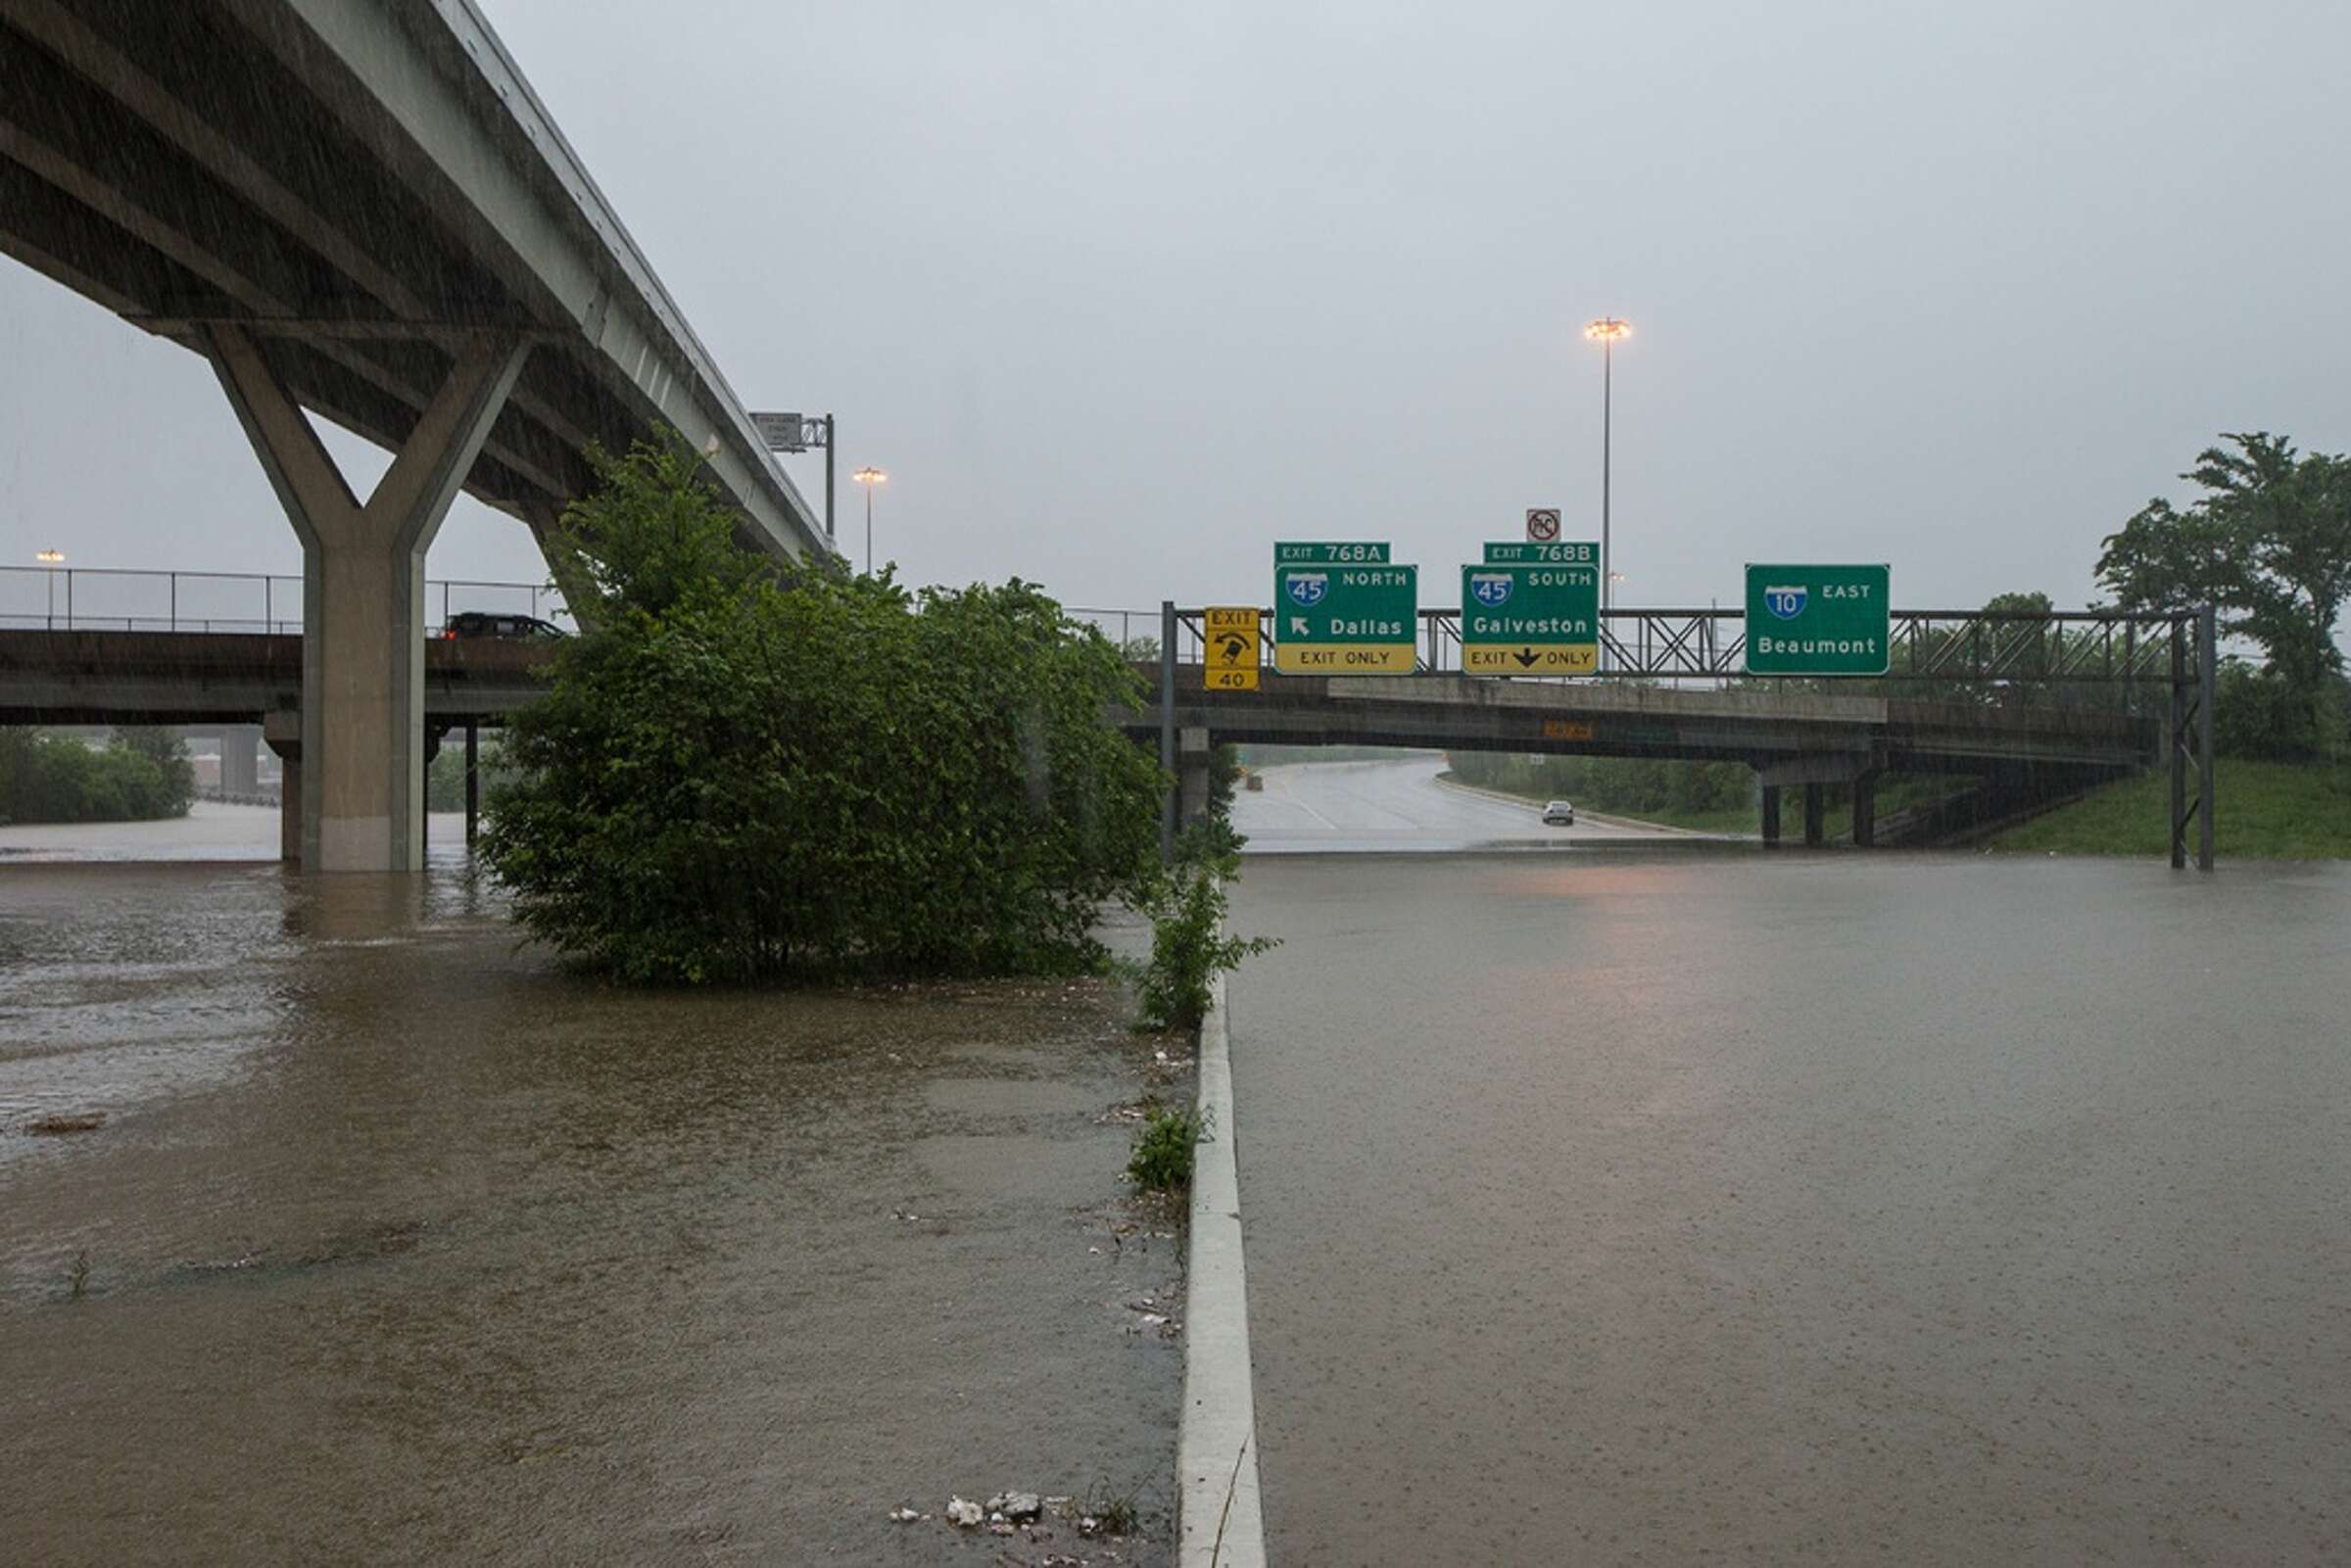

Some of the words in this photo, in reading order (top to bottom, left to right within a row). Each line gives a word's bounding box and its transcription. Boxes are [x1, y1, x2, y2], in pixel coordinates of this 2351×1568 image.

[1282, 547, 1313, 558] EXIT
[1324, 546, 1381, 561] 768A
[1492, 547, 1522, 558] EXIT
[1536, 546, 1591, 561] 768B
[1342, 572, 1407, 586] NORTH
[1528, 572, 1592, 586] SOUTH
[1292, 582, 1321, 599] 45
[1477, 582, 1507, 599] 45
[1822, 586, 1871, 598] EAST
[1775, 594, 1797, 613] 10
[1212, 611, 1252, 625] EXIT
[1473, 617, 1587, 634] Galveston
[1330, 619, 1402, 635] Dallas
[1758, 638, 1876, 654] Beaumont
[1300, 651, 1336, 664] EXIT
[1346, 651, 1391, 664] ONLY
[1470, 651, 1507, 664] EXIT
[1547, 651, 1592, 664] ONLY
[1219, 674, 1245, 686] 40
